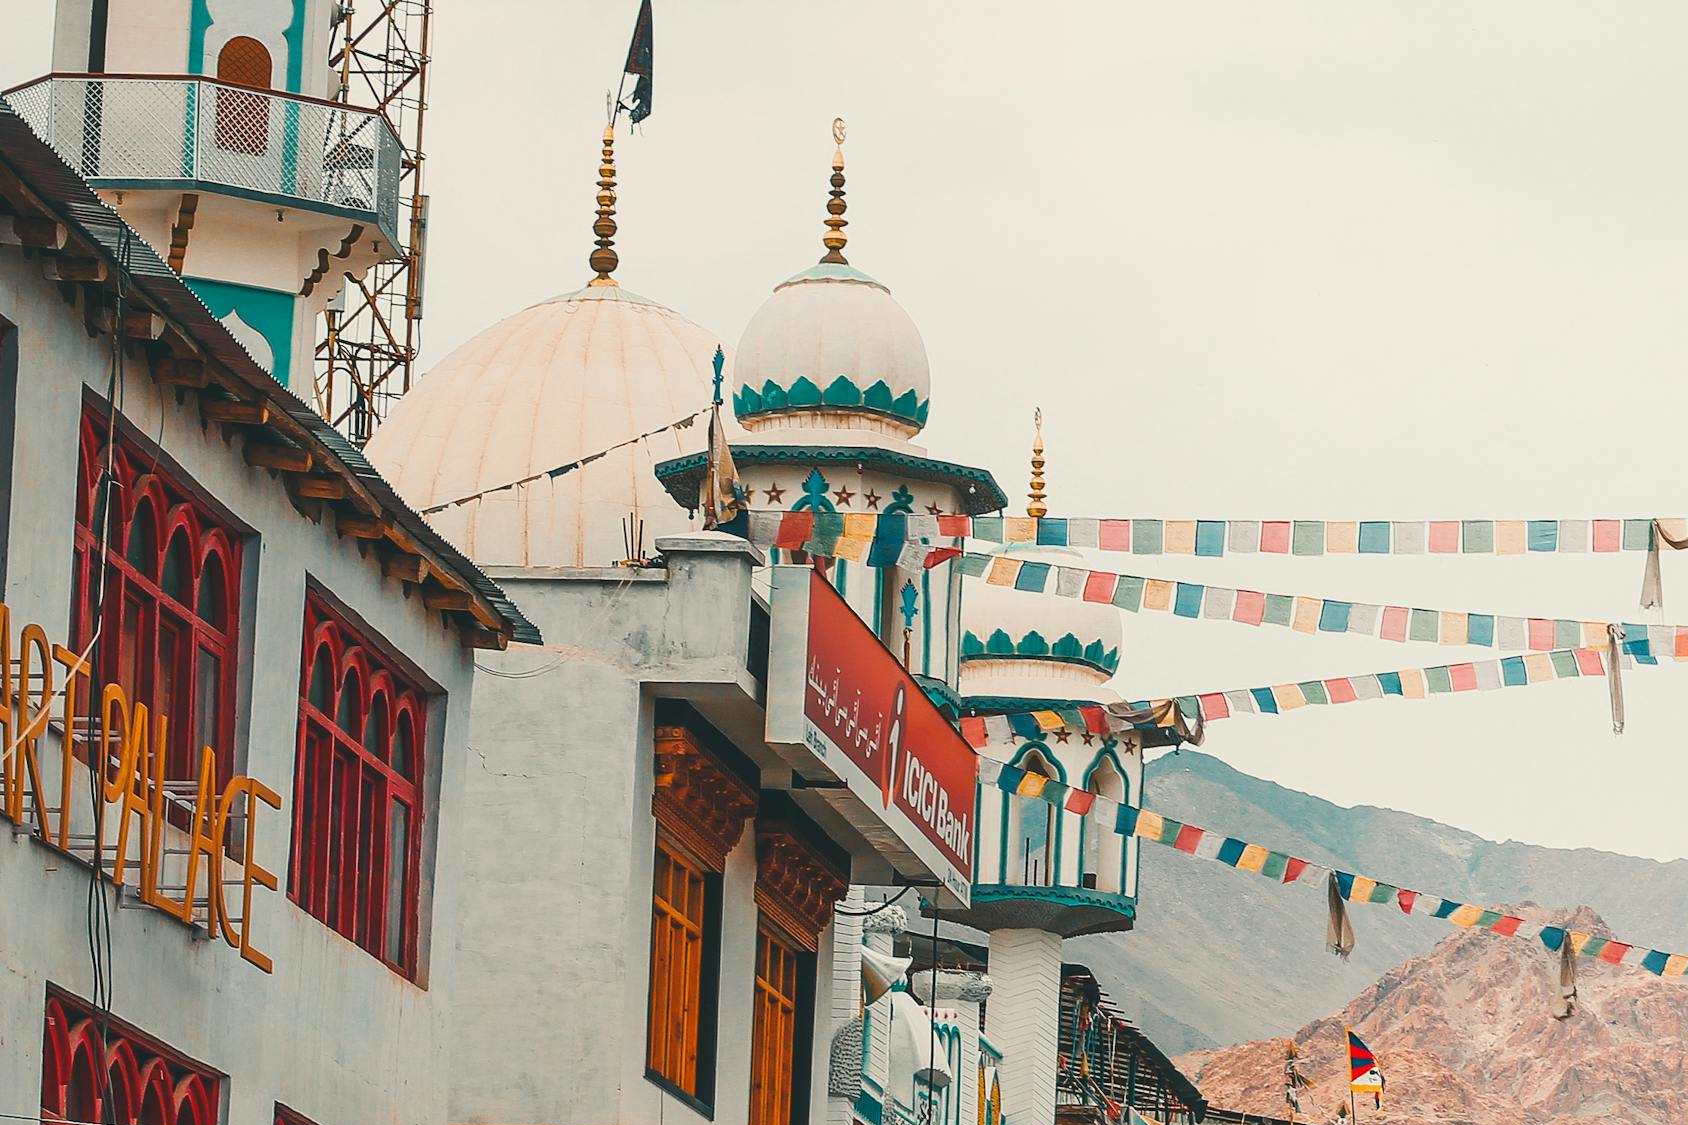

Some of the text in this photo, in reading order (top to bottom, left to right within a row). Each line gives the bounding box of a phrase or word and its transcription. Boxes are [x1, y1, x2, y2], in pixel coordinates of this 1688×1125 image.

[96, 683, 282, 974] PALACE
[902, 750, 939, 829] ICICI
[937, 786, 971, 866] Bank
